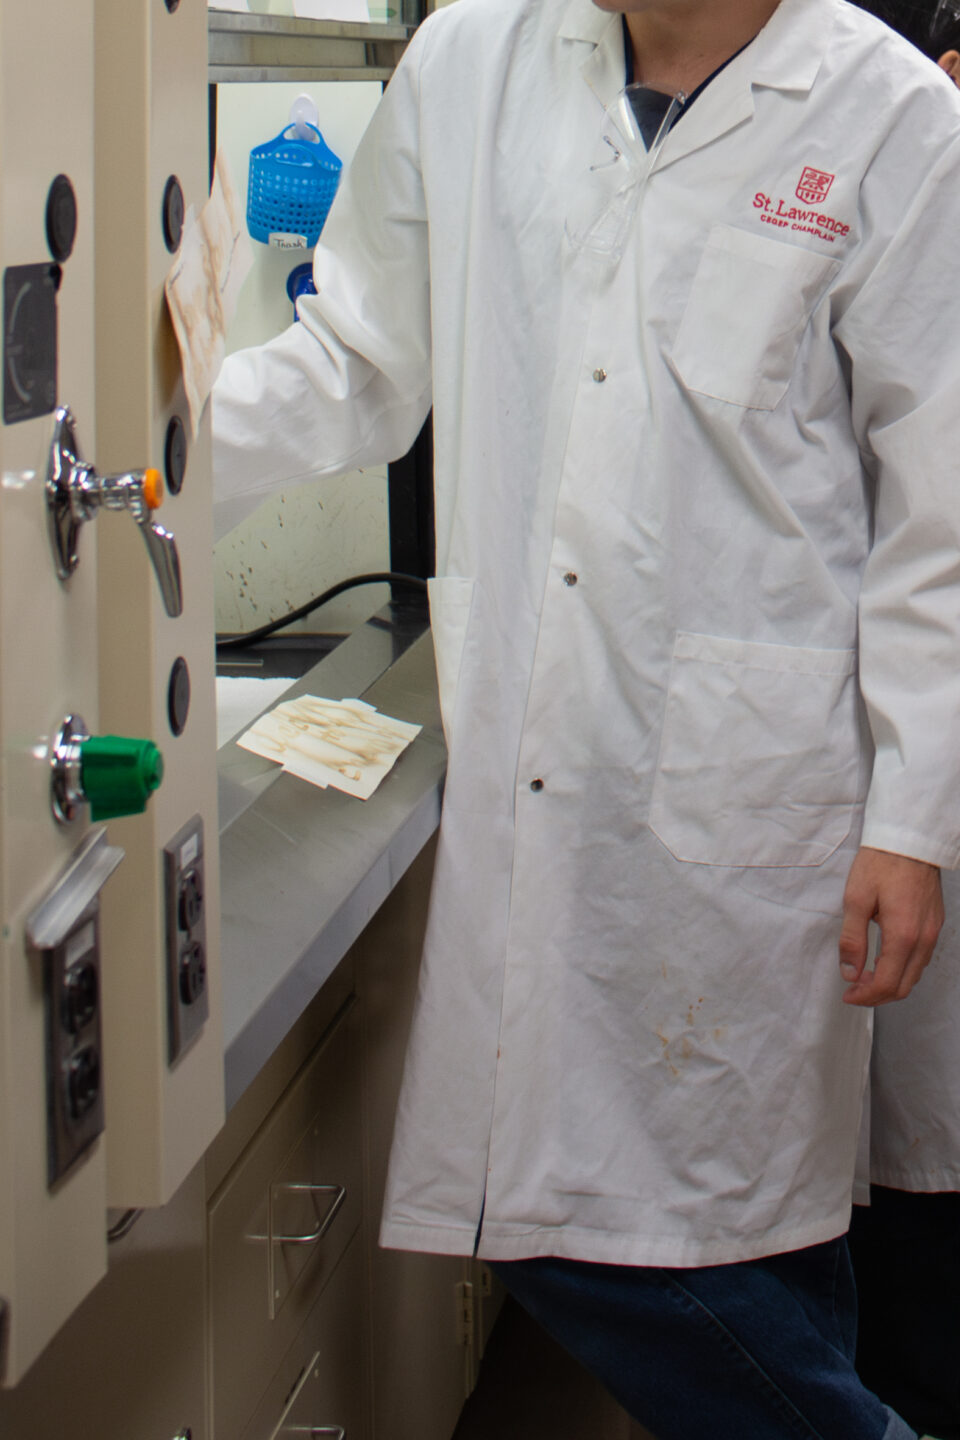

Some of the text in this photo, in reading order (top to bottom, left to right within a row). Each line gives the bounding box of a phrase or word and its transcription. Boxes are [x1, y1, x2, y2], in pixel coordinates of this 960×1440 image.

[752, 192, 850, 236] St. Lawrence
[760, 214, 836, 243] CEGEP CHAMPLAIN
